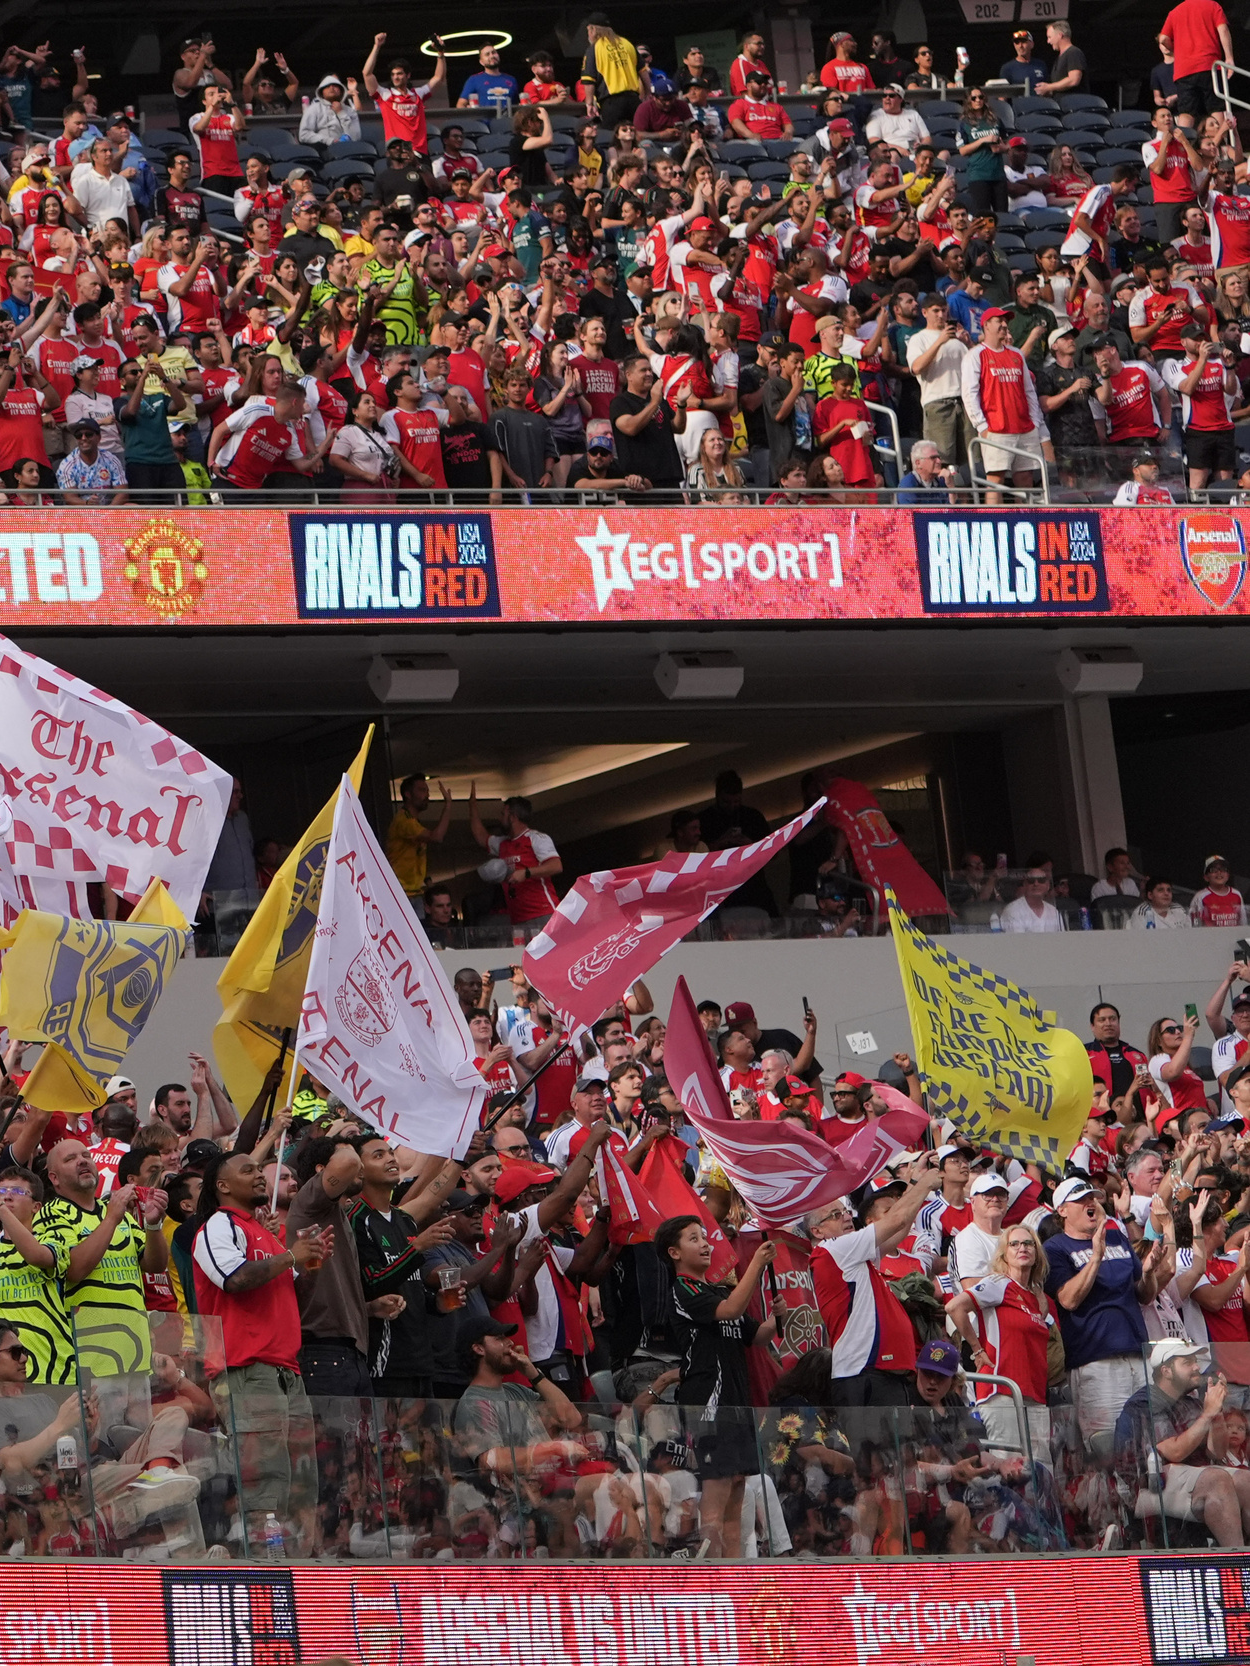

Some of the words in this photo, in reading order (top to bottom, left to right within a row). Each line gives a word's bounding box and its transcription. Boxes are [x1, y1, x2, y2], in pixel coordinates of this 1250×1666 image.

[975, 4, 1000, 18] 202
[1034, 2, 1056, 16] 201
[991, 367, 1023, 376] Emirates
[586, 383, 617, 394] ARSENAL
[407, 429, 440, 438] Emirates
[250, 436, 283, 457] Emirates
[458, 523, 481, 543] USA
[1069, 521, 1091, 541] USA
[1189, 527, 1240, 543] Arsenal
[459, 544, 487, 564] 2024
[1070, 542, 1097, 561] 2024
[305, 522, 421, 609] RIVALS
[424, 523, 459, 563] IN
[928, 521, 1036, 604] RIVALS
[1038, 522, 1069, 560] IN
[425, 568, 488, 608] RED
[1040, 564, 1097, 602] RED
[31, 709, 115, 777] The
[103, 1270, 114, 1283] FLY
[115, 1268, 138, 1282] BETTER
[13, 1284, 43, 1299] BETTER
